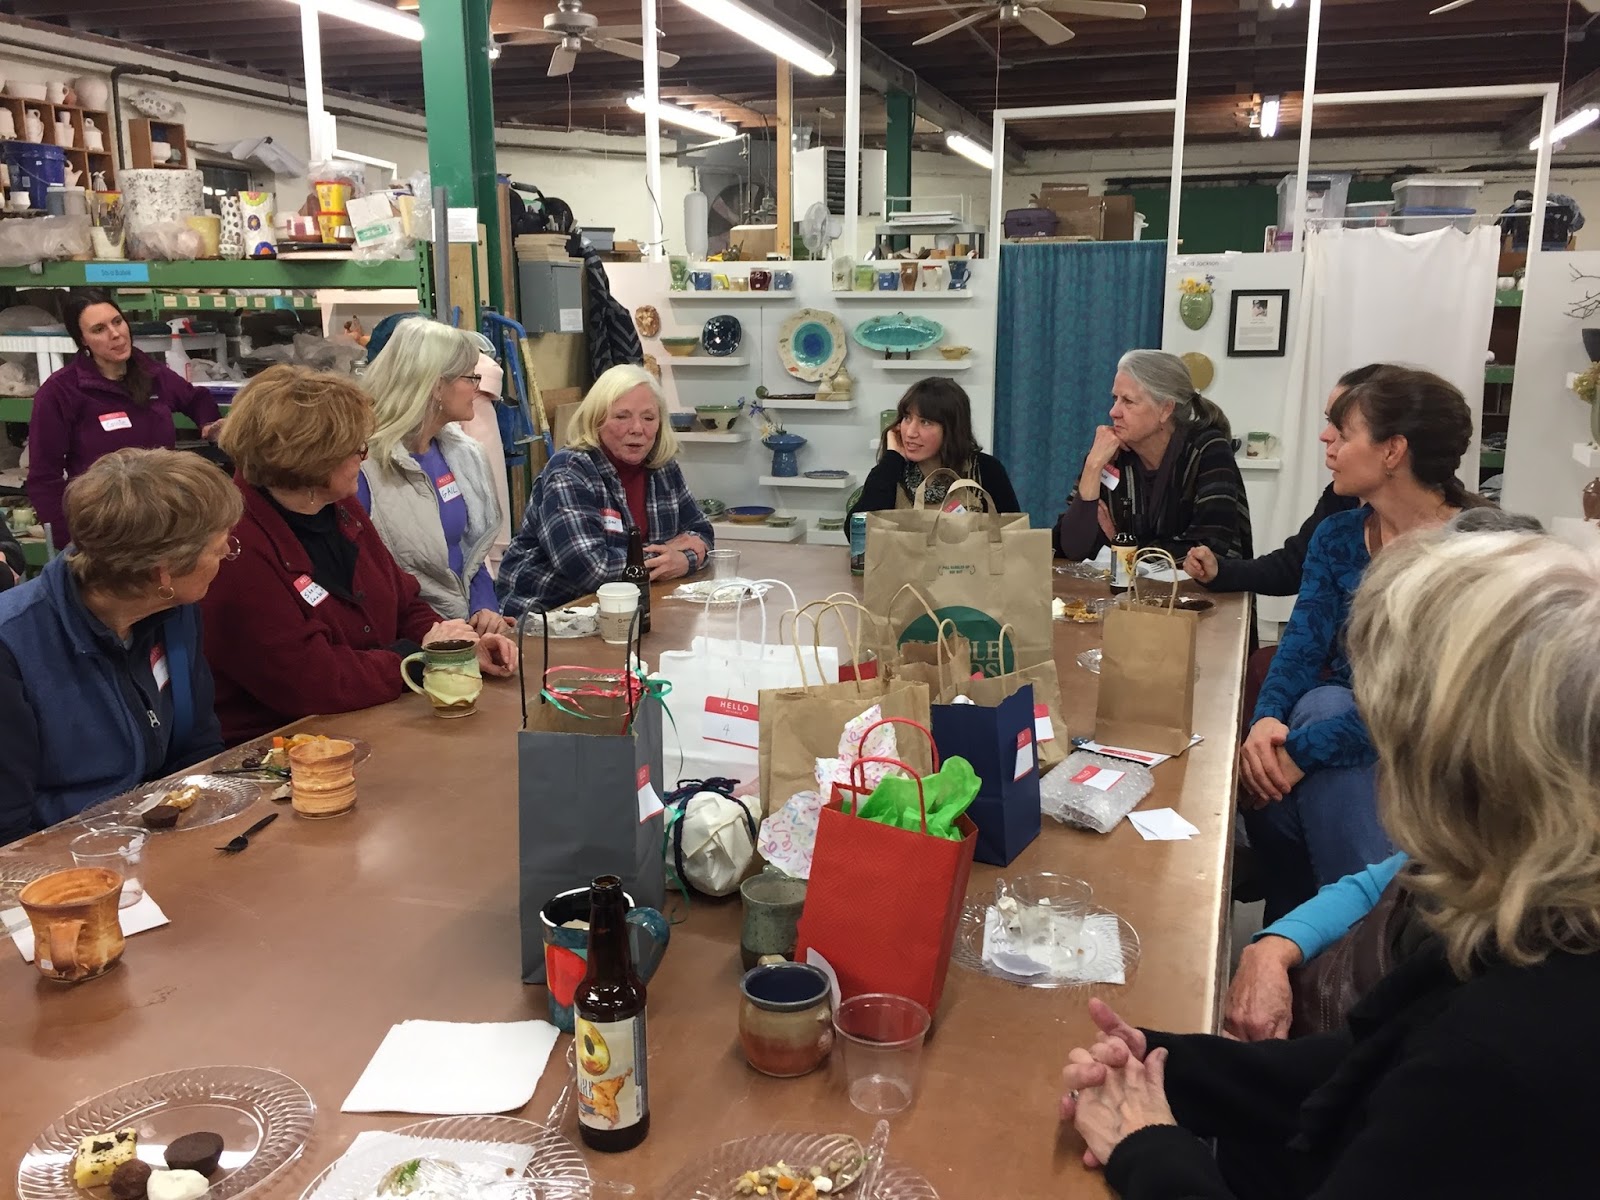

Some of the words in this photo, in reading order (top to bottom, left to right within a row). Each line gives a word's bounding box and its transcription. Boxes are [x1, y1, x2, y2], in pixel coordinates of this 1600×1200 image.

[441, 485, 458, 499] GAIL
[720, 700, 749, 713] HELLO
[722, 723, 730, 736] 4
